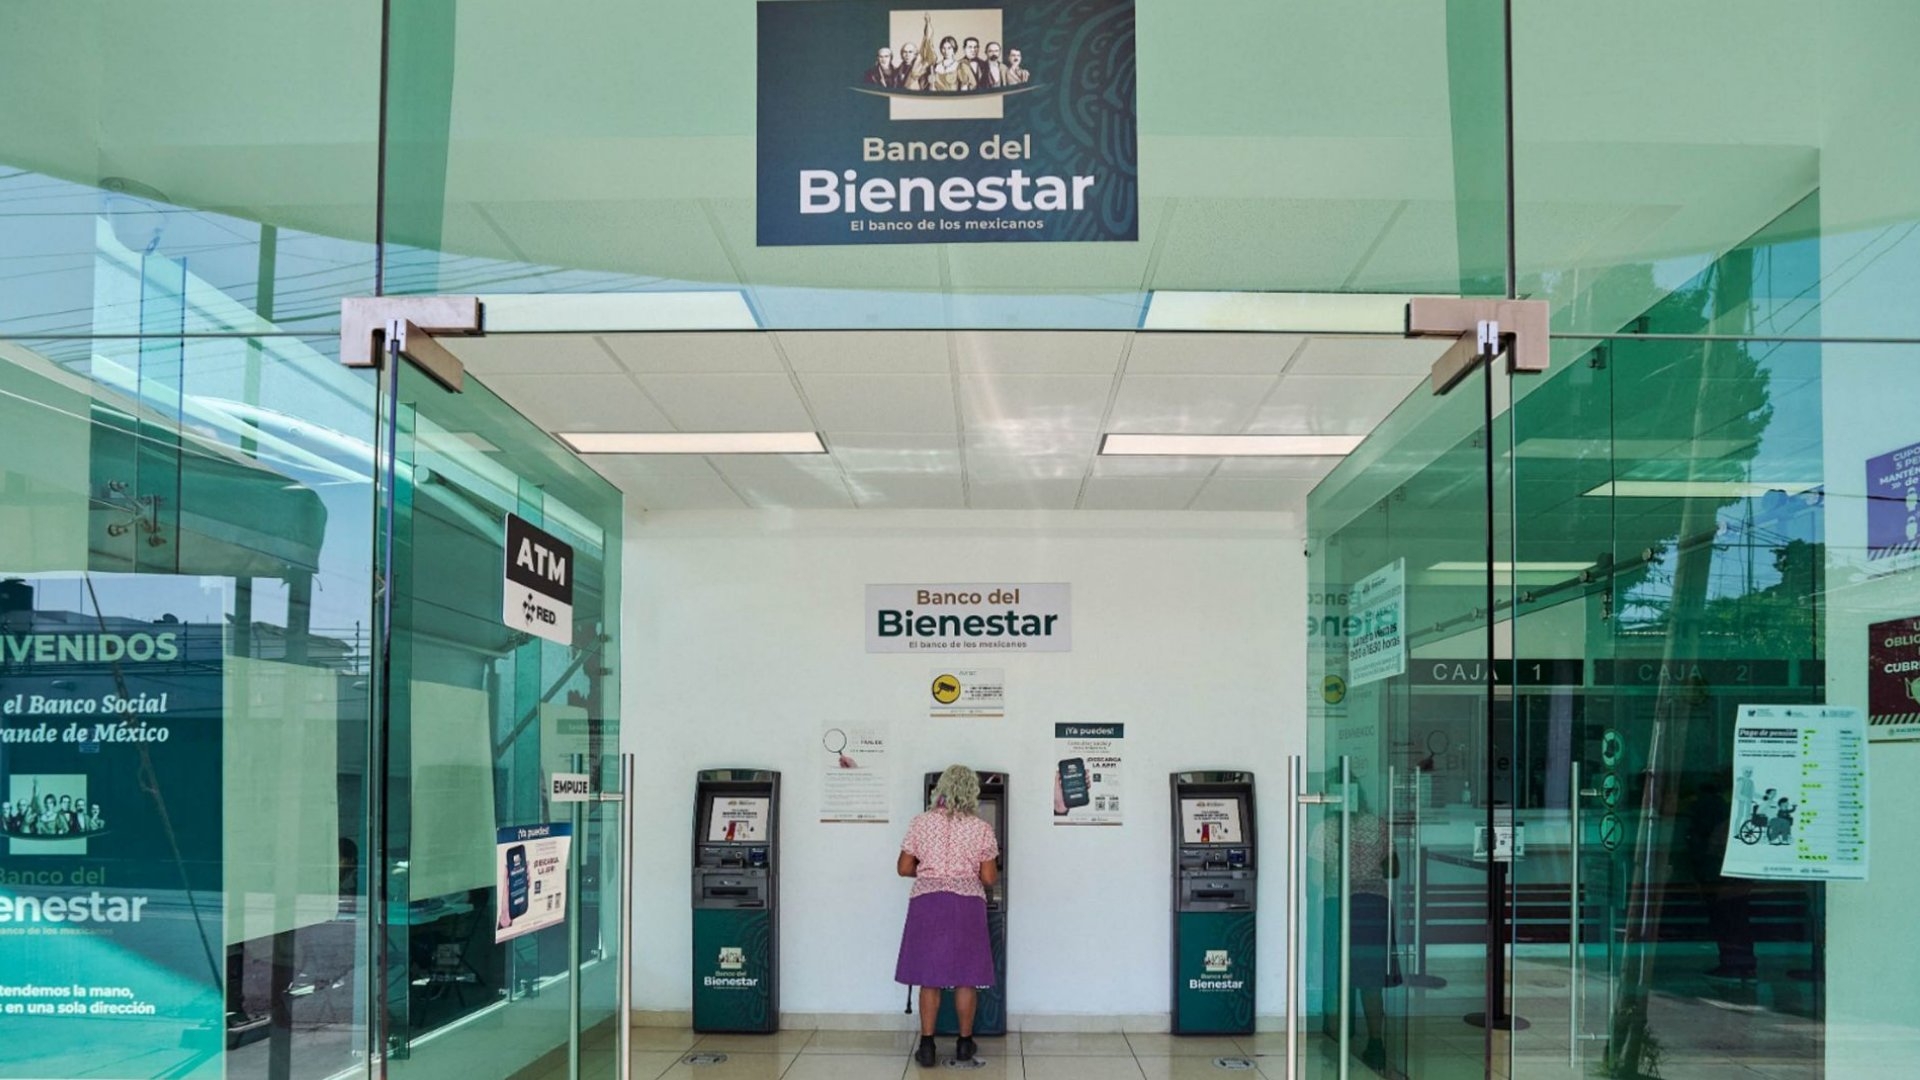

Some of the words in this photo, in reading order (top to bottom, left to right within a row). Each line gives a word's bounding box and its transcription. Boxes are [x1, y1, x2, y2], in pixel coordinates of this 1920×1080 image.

[863, 137, 969, 162] Banco
[979, 134, 1031, 160] del
[799, 169, 1095, 214] Bienestar
[850, 220, 864, 231] El
[869, 220, 913, 231] banco
[917, 219, 936, 230] de
[940, 218, 961, 230] los
[965, 217, 1044, 230] mexicanos
[1905, 454, 1920, 467] PE
[516, 537, 566, 587] ATM
[917, 589, 982, 605] Banco
[988, 588, 1020, 604] del
[536, 605, 556, 625] RED
[878, 610, 1058, 637] Bienestar
[0, 633, 178, 662] VENIDOS
[1433, 664, 1499, 681] CAJA
[1532, 664, 1541, 681] 1
[1638, 664, 1702, 681] CAJA
[1736, 664, 1748, 681] 2
[1884, 661, 1920, 673] CUBR
[4, 694, 23, 714] el
[28, 695, 96, 714] Banco
[101, 693, 167, 714] Social
[62, 722, 87, 742] de
[92, 721, 169, 742] México
[1065, 727, 1078, 735] ¡Ya
[1080, 727, 1114, 735] puedes!
[553, 780, 588, 794] EMPUJE
[70, 867, 106, 884] del
[704, 976, 758, 986] Bienestar
[1190, 979, 1244, 989] Bienestar
[73, 984, 86, 997] la
[89, 987, 134, 999] mano,
[5, 1003, 24, 1014] en
[27, 1003, 54, 1014] una
[57, 1001, 87, 1014] sola
[90, 1001, 155, 1015] dirección
